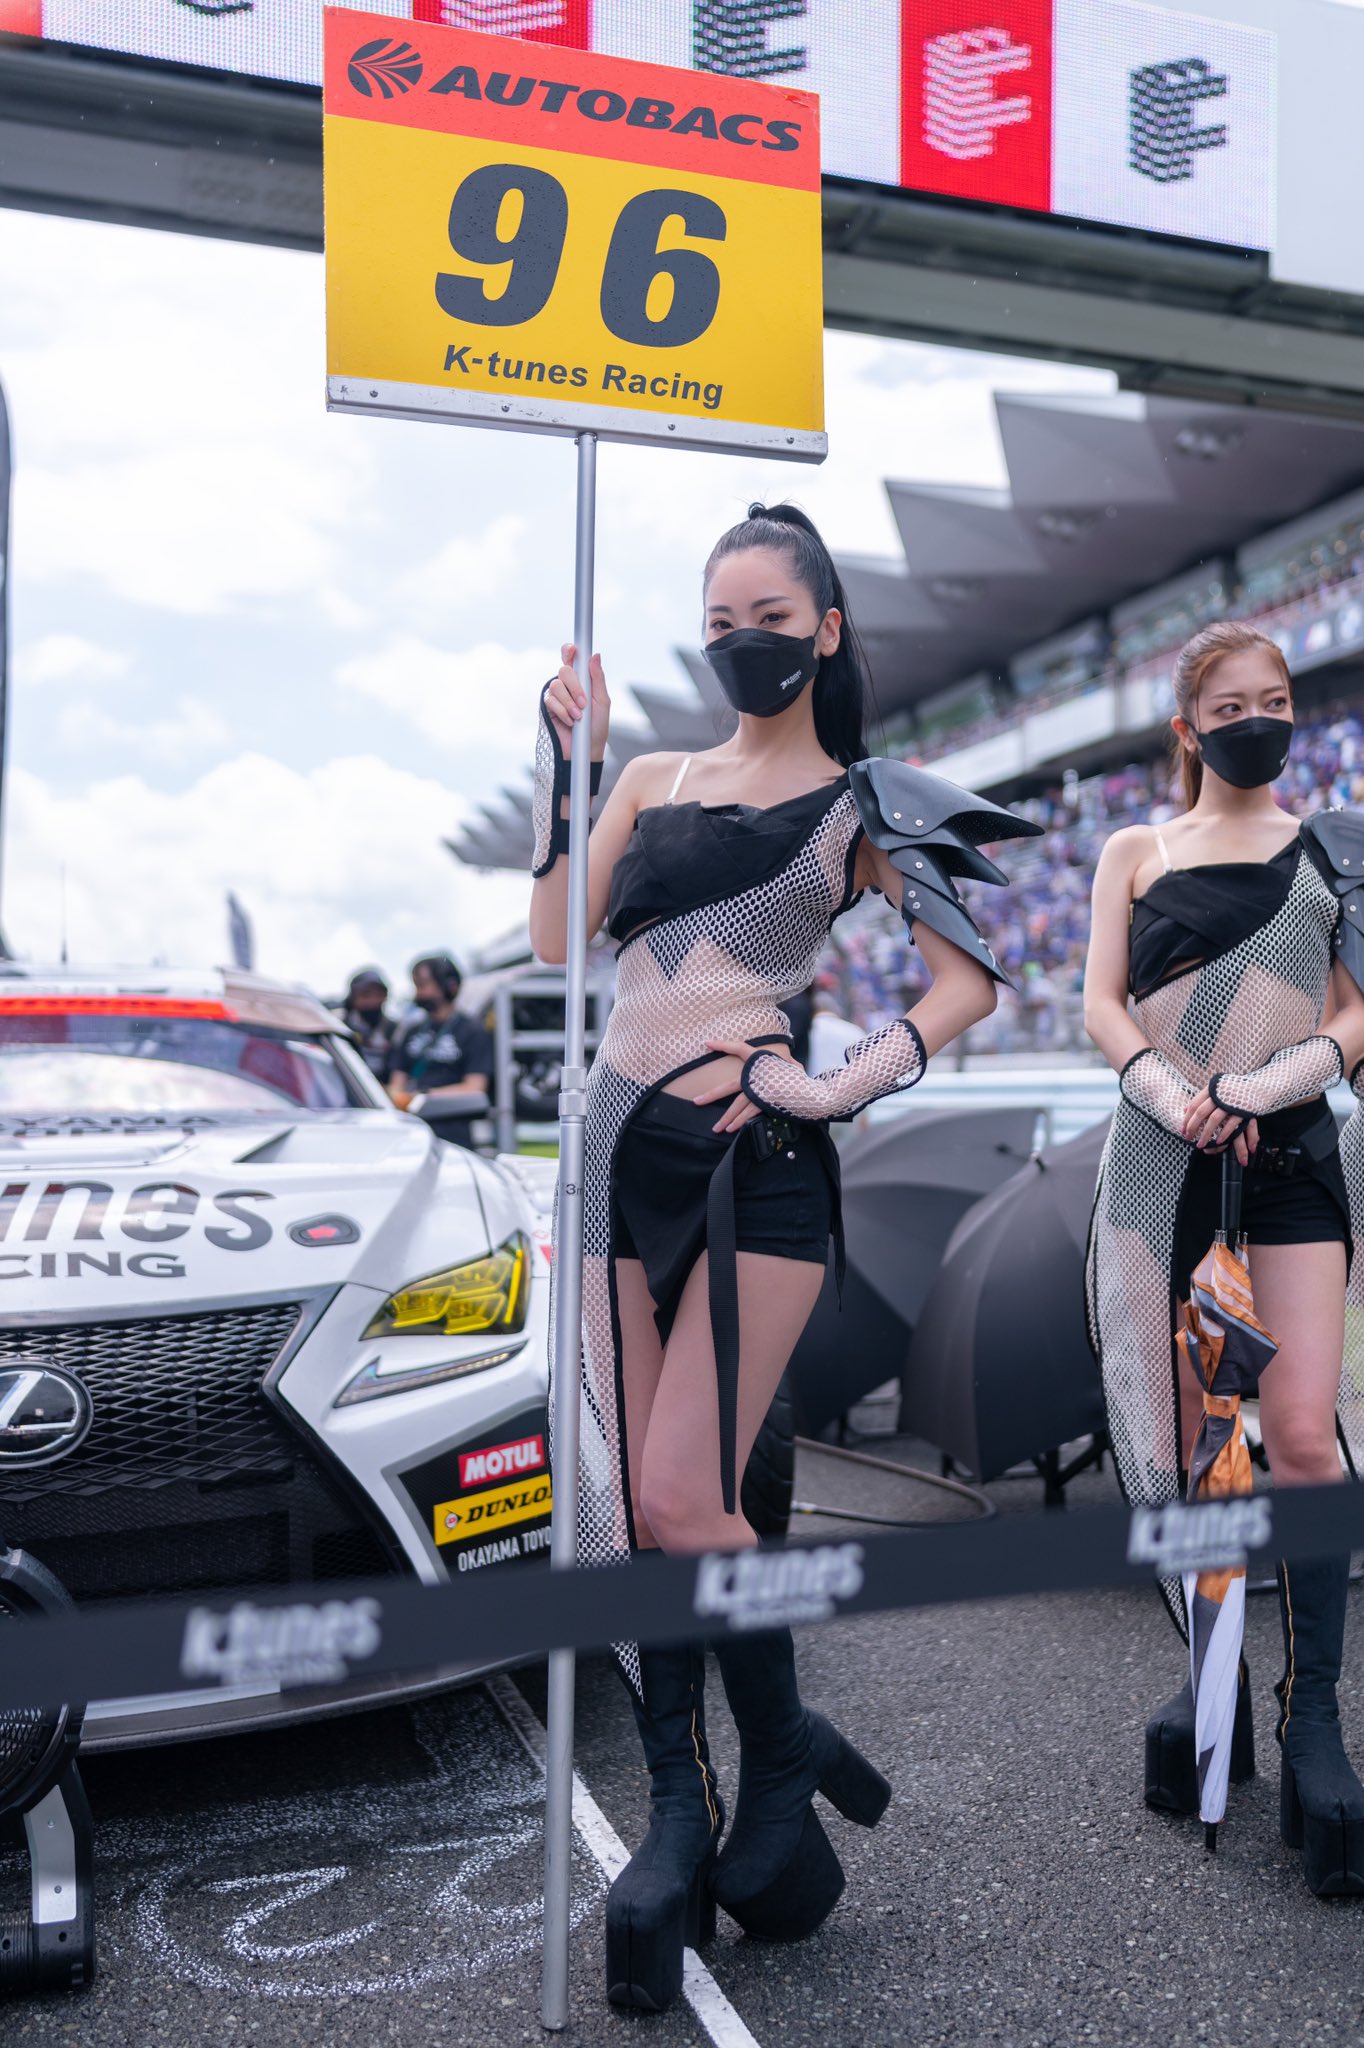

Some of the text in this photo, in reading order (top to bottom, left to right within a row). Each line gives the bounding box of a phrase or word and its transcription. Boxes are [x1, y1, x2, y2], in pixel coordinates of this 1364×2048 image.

[428, 65, 801, 151] AUTOBACS
[435, 163, 727, 347] 96
[443, 344, 723, 410] K-tunes Racing
[464, 1441, 541, 1482] MOTUL
[465, 1486, 552, 1523] DUNLO
[458, 1537, 520, 1571] OKAYAMA
